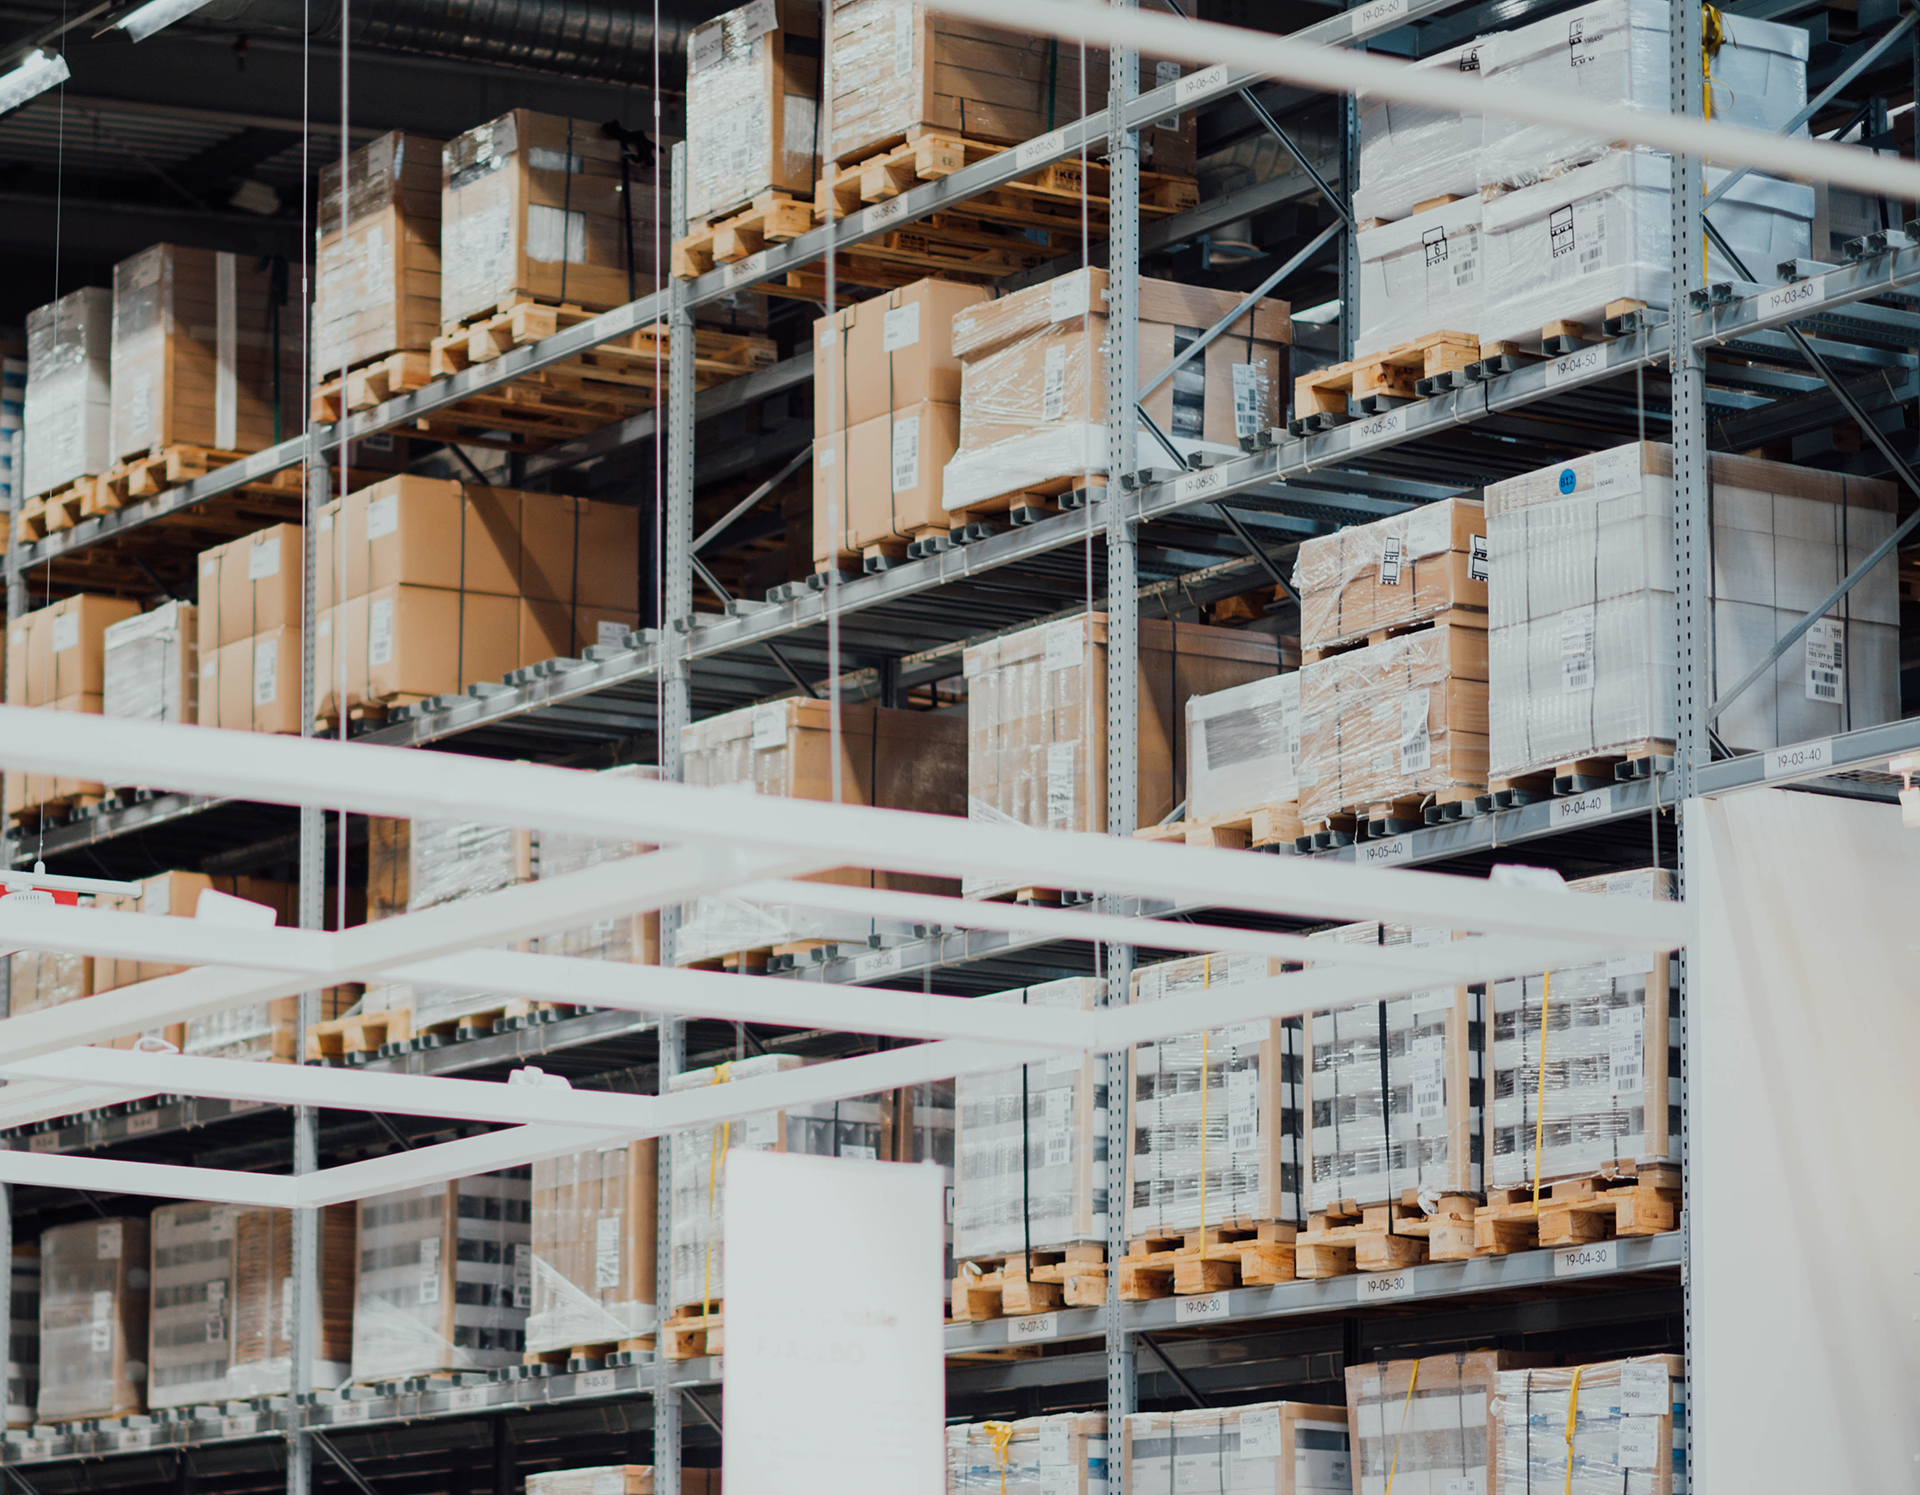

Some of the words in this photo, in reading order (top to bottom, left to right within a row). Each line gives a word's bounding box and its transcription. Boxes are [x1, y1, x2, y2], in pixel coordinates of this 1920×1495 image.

[1361, 0, 1399, 23] 19-05-60
[1583, 34, 1604, 44] 190450
[1185, 71, 1220, 94] 19-06-60
[1053, 169, 1081, 181] IKEA
[1433, 243, 1440, 255] 6
[1770, 283, 1814, 308] 19-03-50
[1556, 352, 1597, 376] 19-04-50
[1360, 416, 1398, 437] 19-05-50
[1184, 473, 1219, 489] 19-06-50
[1559, 475, 1574, 487] B12
[1777, 748, 1822, 768] 19-03-40
[1560, 797, 1602, 816] 19-04-40
[1365, 842, 1403, 860] 19-05-40
[863, 955, 894, 971] 19-08-40
[1565, 1249, 1607, 1267] 19-04-30
[1366, 1277, 1405, 1293] 19-05-30
[1184, 1299, 1220, 1314] 19-06-30
[1016, 1319, 1049, 1333] 19-07-30
[1622, 1391, 1640, 1399] 190420
[1620, 1445, 1638, 1453] 190420
